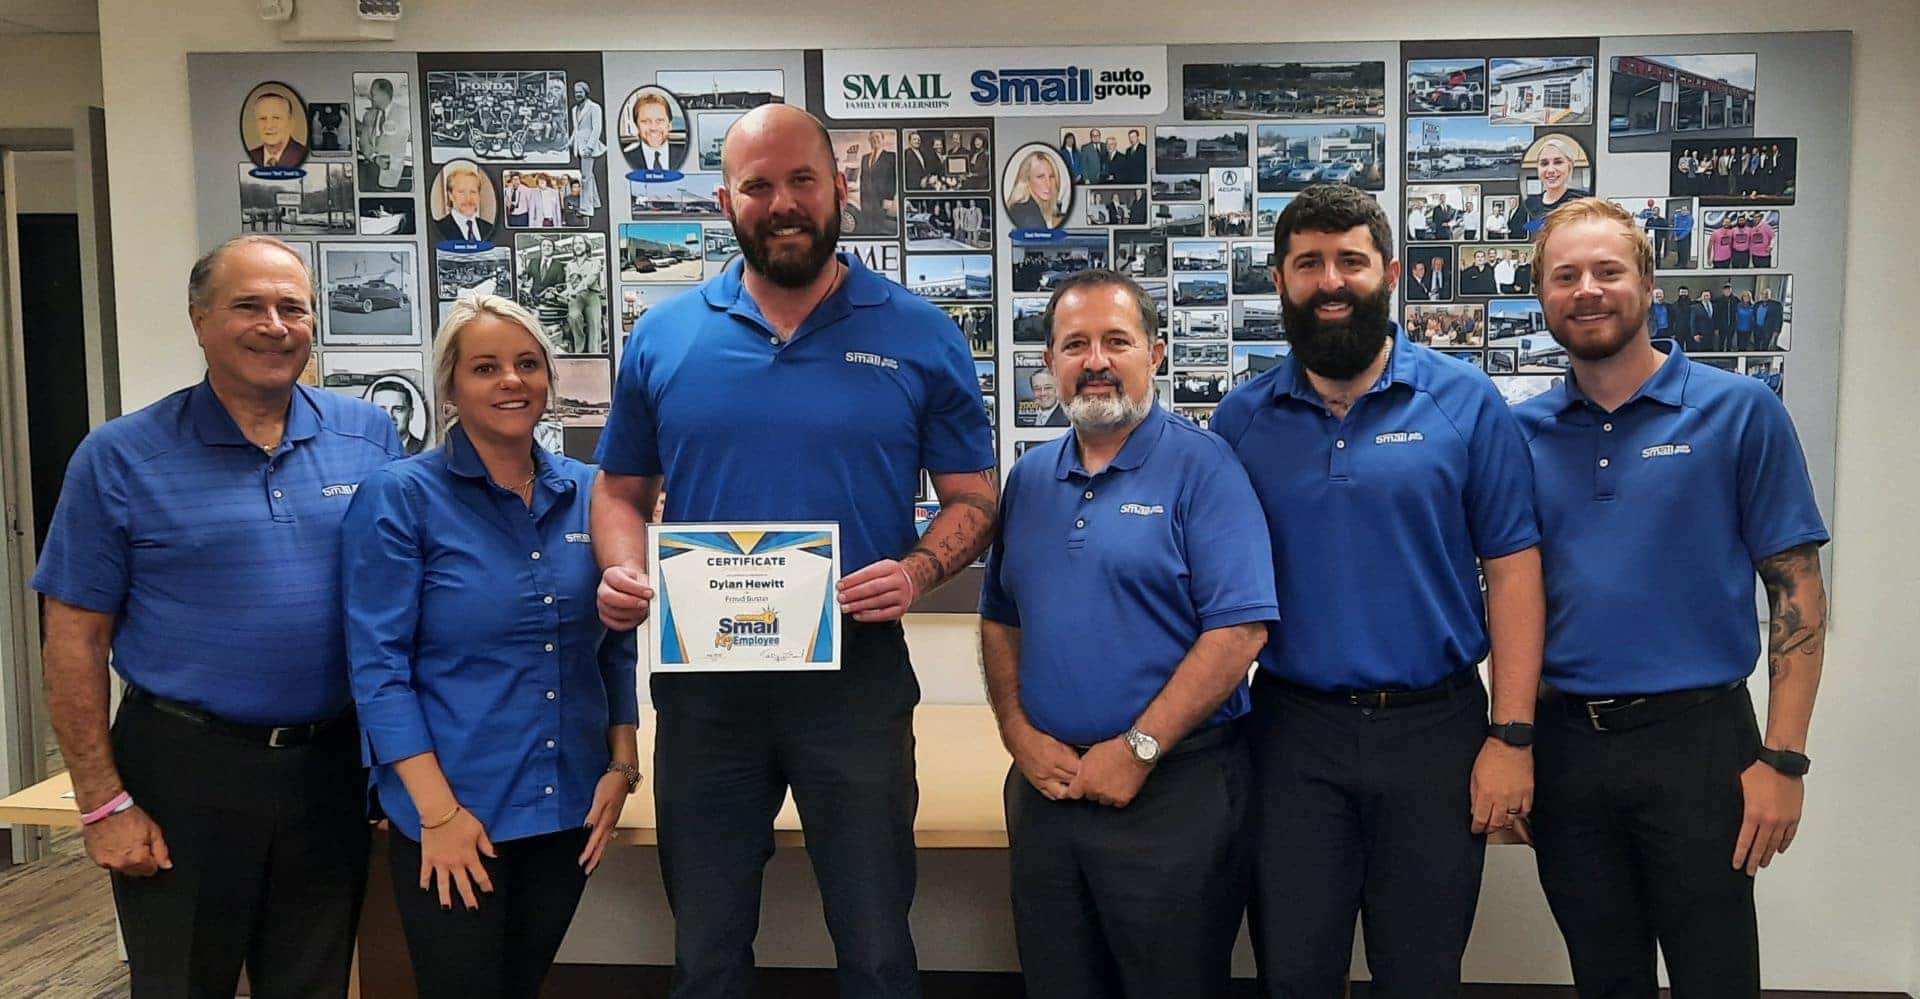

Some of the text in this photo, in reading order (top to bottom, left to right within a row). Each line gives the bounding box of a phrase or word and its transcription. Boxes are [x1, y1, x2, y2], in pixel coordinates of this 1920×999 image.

[1100, 68, 1144, 82] auto
[842, 74, 952, 101] SMAIL
[970, 66, 1093, 106] Smail
[1094, 83, 1151, 99] group
[845, 351, 881, 366] Smail
[707, 557, 786, 566] CERTIFICATE
[709, 579, 785, 591] Dylan Hewitt
[719, 616, 779, 634] Smail
[733, 635, 780, 647] Employee
